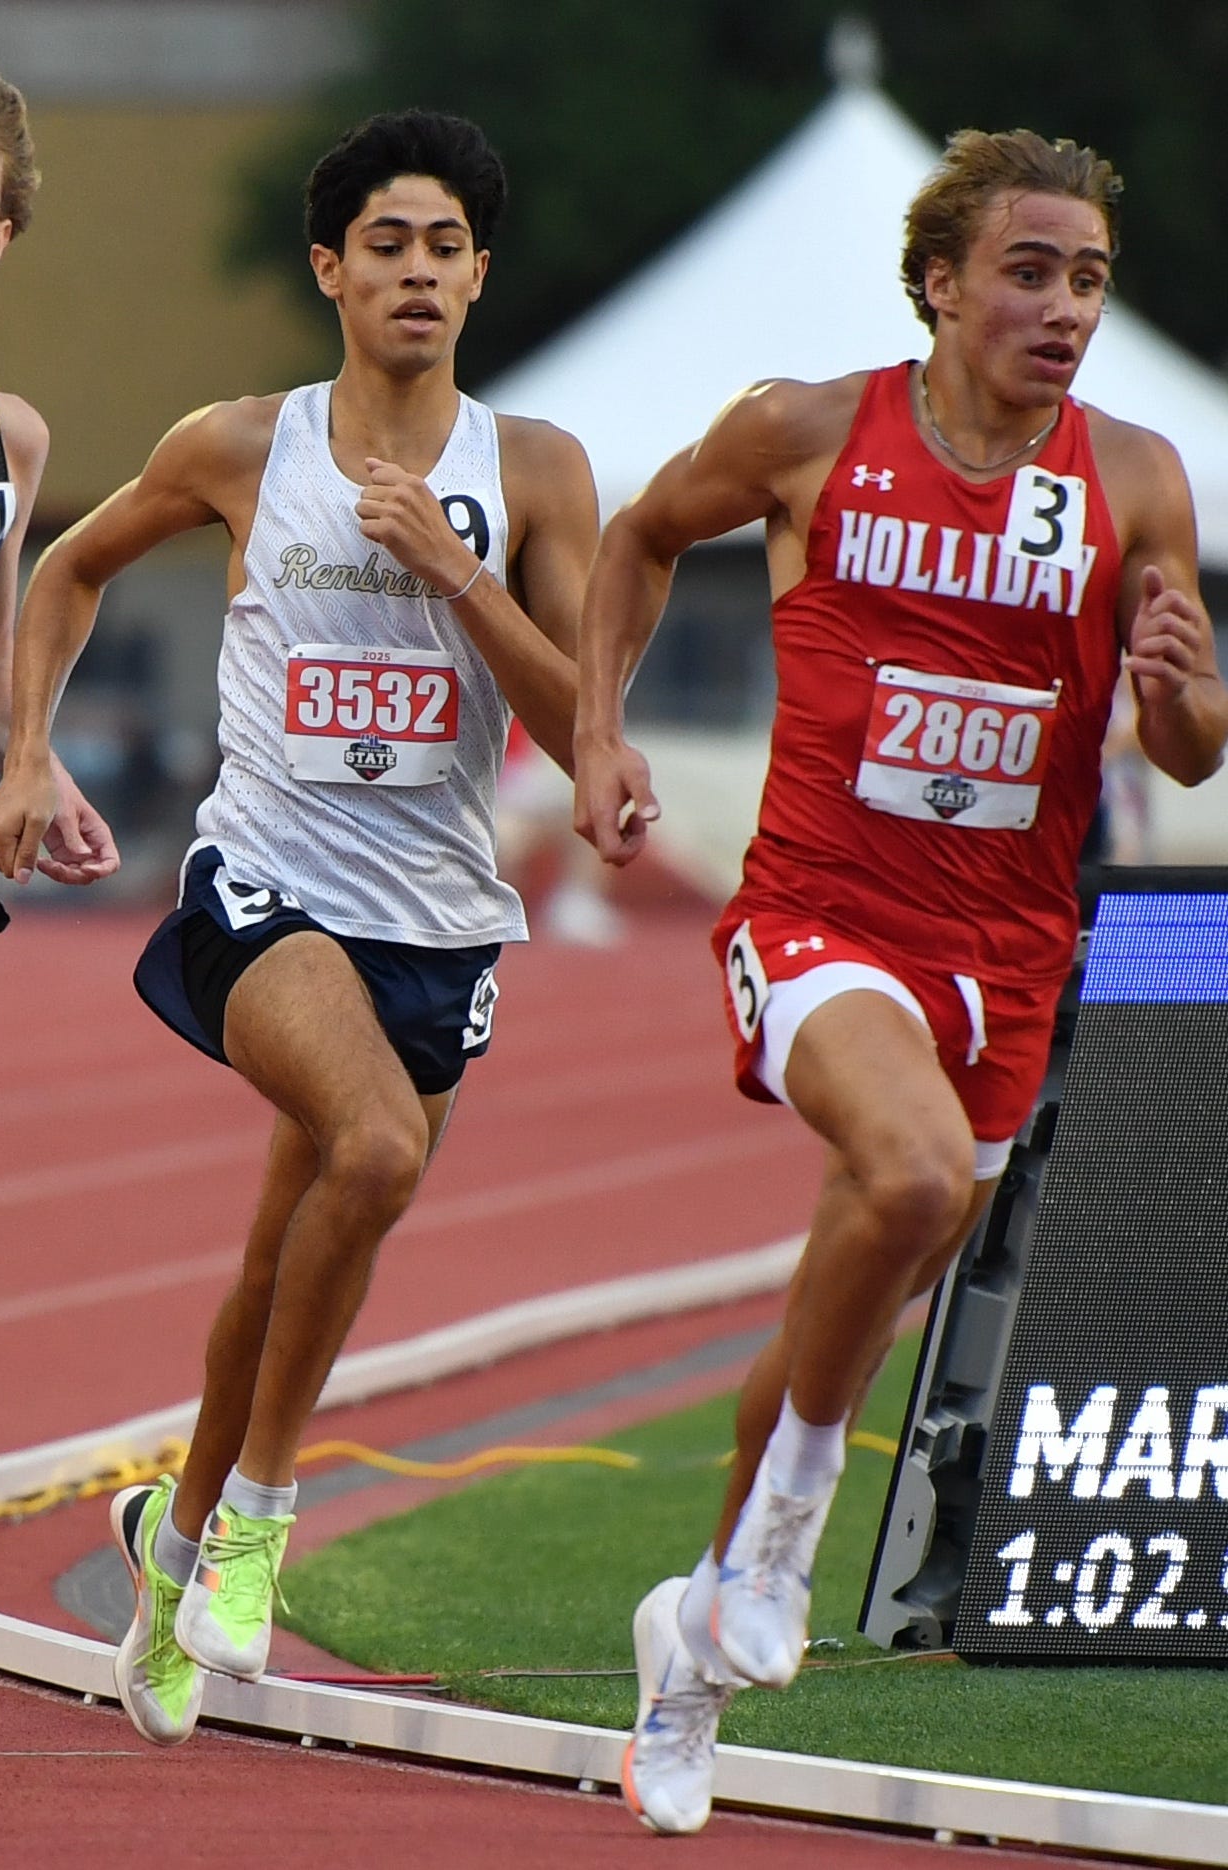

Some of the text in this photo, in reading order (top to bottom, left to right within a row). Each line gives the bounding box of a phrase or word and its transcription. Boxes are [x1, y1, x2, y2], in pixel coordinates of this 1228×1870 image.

[438, 494, 490, 562] 9
[1019, 475, 1069, 556] 3
[836, 509, 1099, 617] HOLLIDAY
[361, 651, 391, 662] 2025
[297, 665, 451, 735] 3532
[876, 692, 1042, 777] 2860
[344, 750, 397, 767] STATE
[731, 943, 758, 1028] 3
[983, 1529, 1228, 1630] 1:02.
